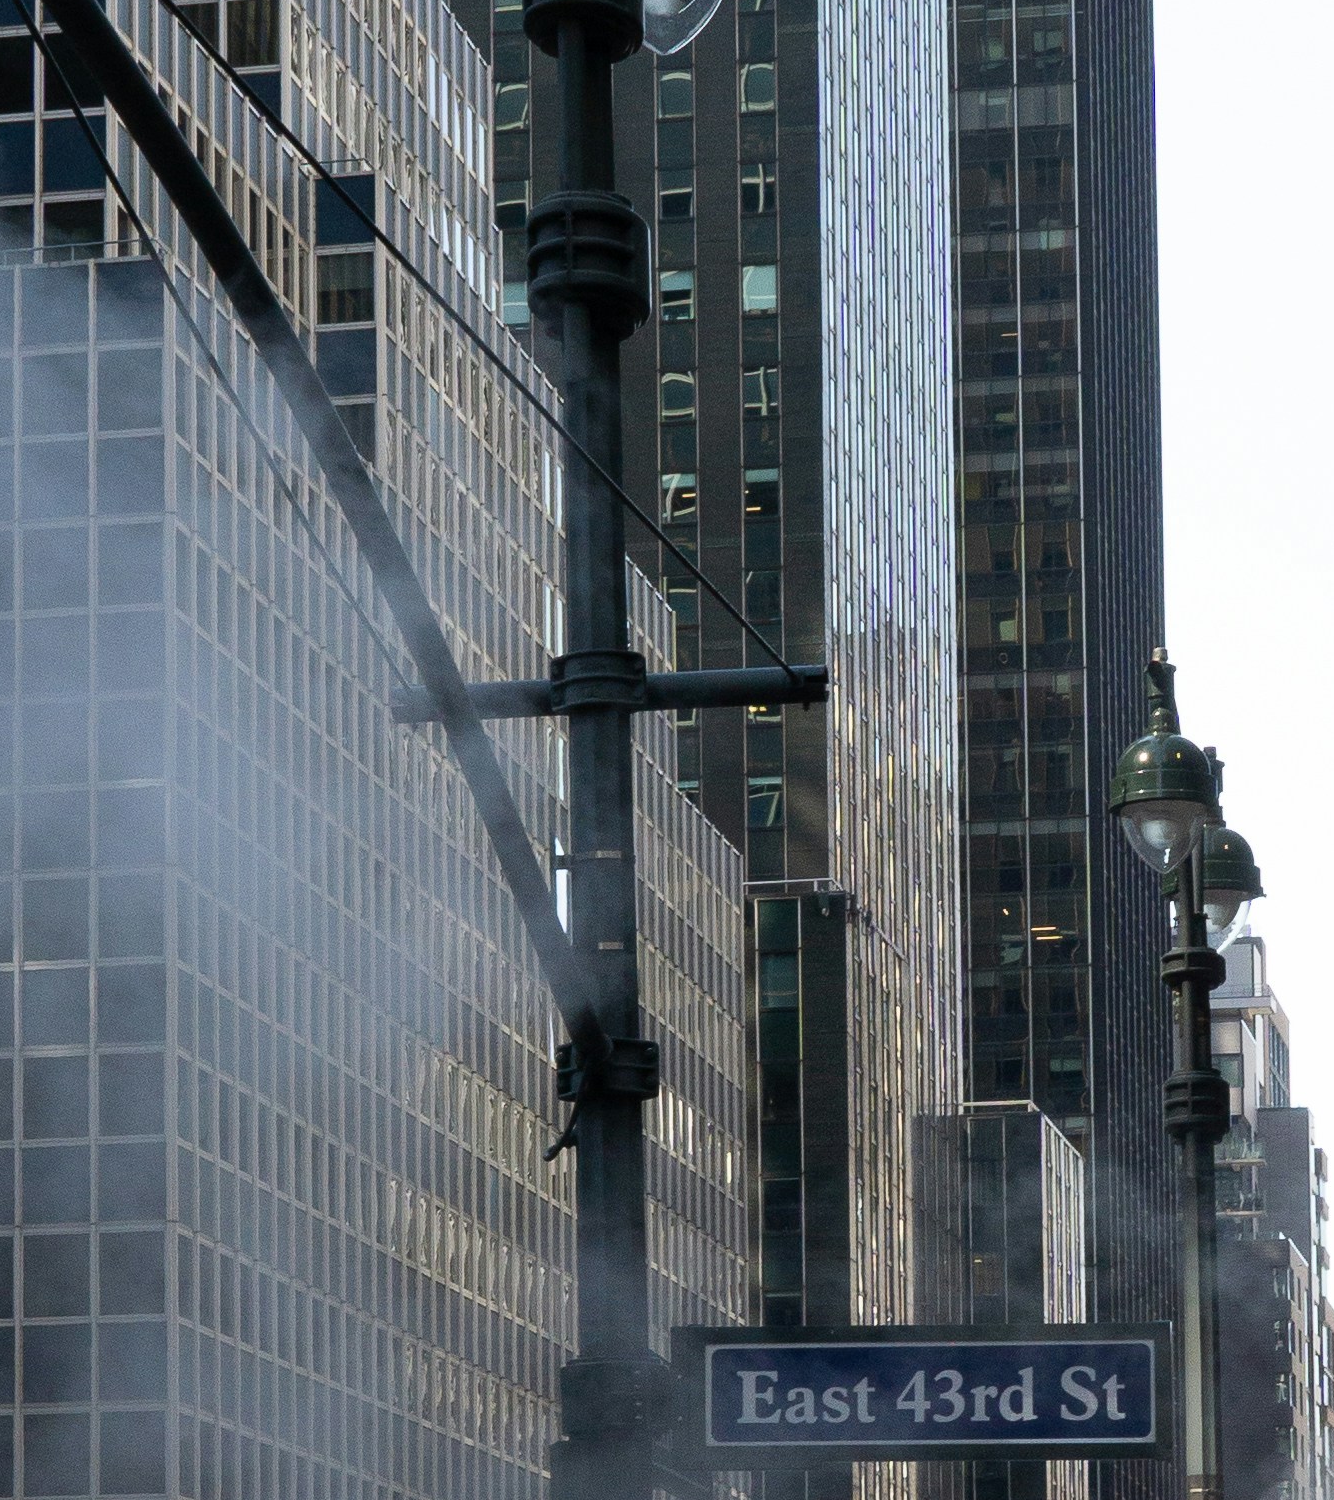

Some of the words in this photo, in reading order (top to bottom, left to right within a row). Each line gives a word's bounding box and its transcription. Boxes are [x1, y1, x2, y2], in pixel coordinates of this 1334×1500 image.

[736, 1369, 876, 1425] East
[895, 1366, 1039, 1424] 43rd
[1059, 1365, 1127, 1422] St
